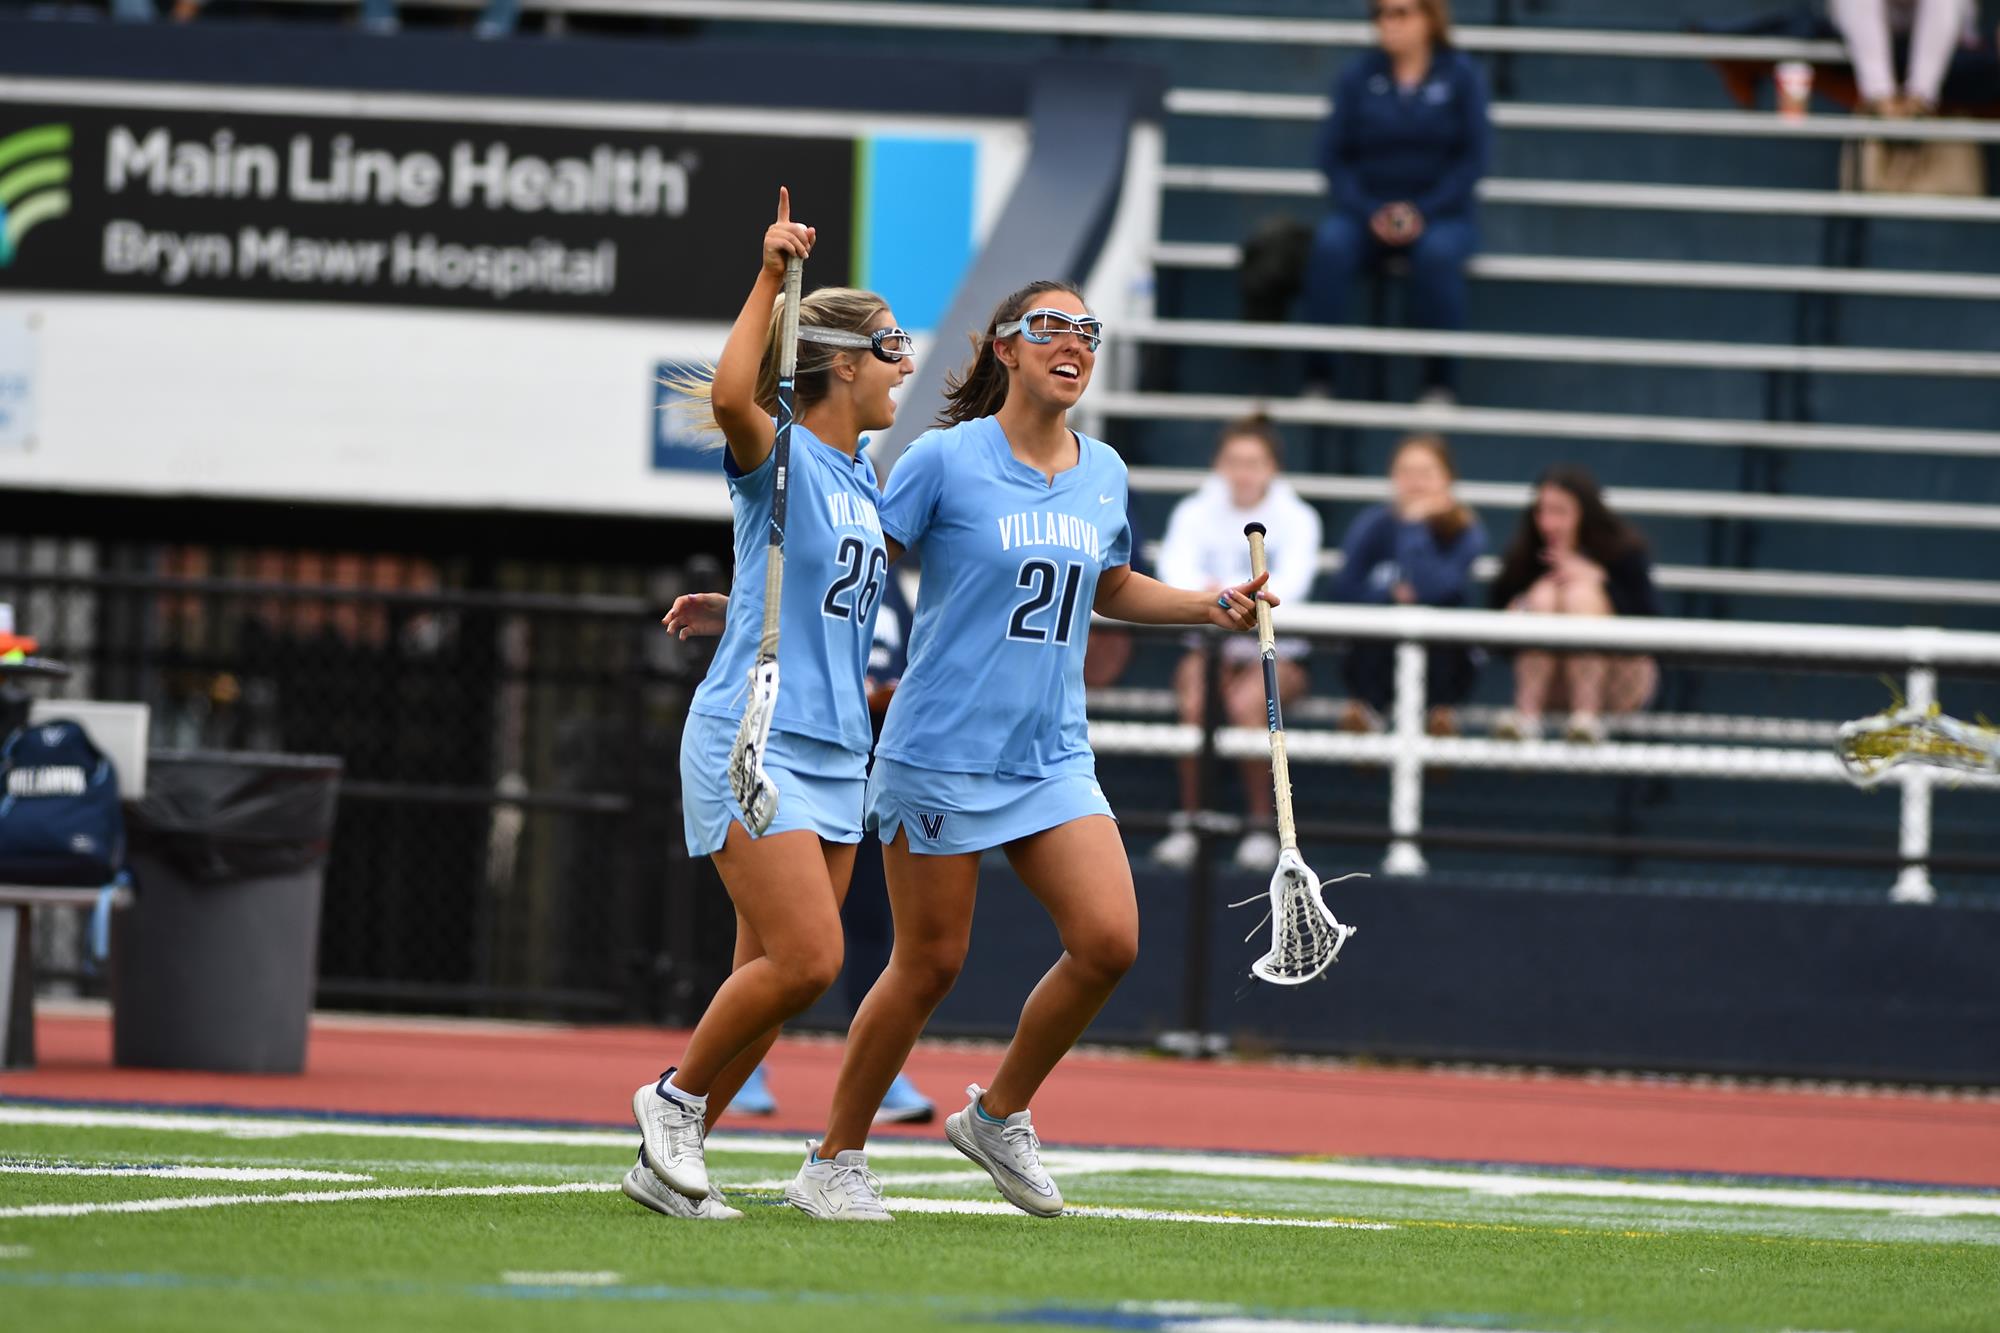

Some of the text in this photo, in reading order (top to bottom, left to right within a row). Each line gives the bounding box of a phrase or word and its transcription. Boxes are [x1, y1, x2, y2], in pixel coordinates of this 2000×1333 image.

[105, 125, 689, 216] Main Line Health
[104, 221, 616, 294] Bryn Mawr Hospital
[821, 534, 888, 628] 26
[997, 511, 1099, 563] VILLANOVA
[1006, 557, 1084, 647] 21
